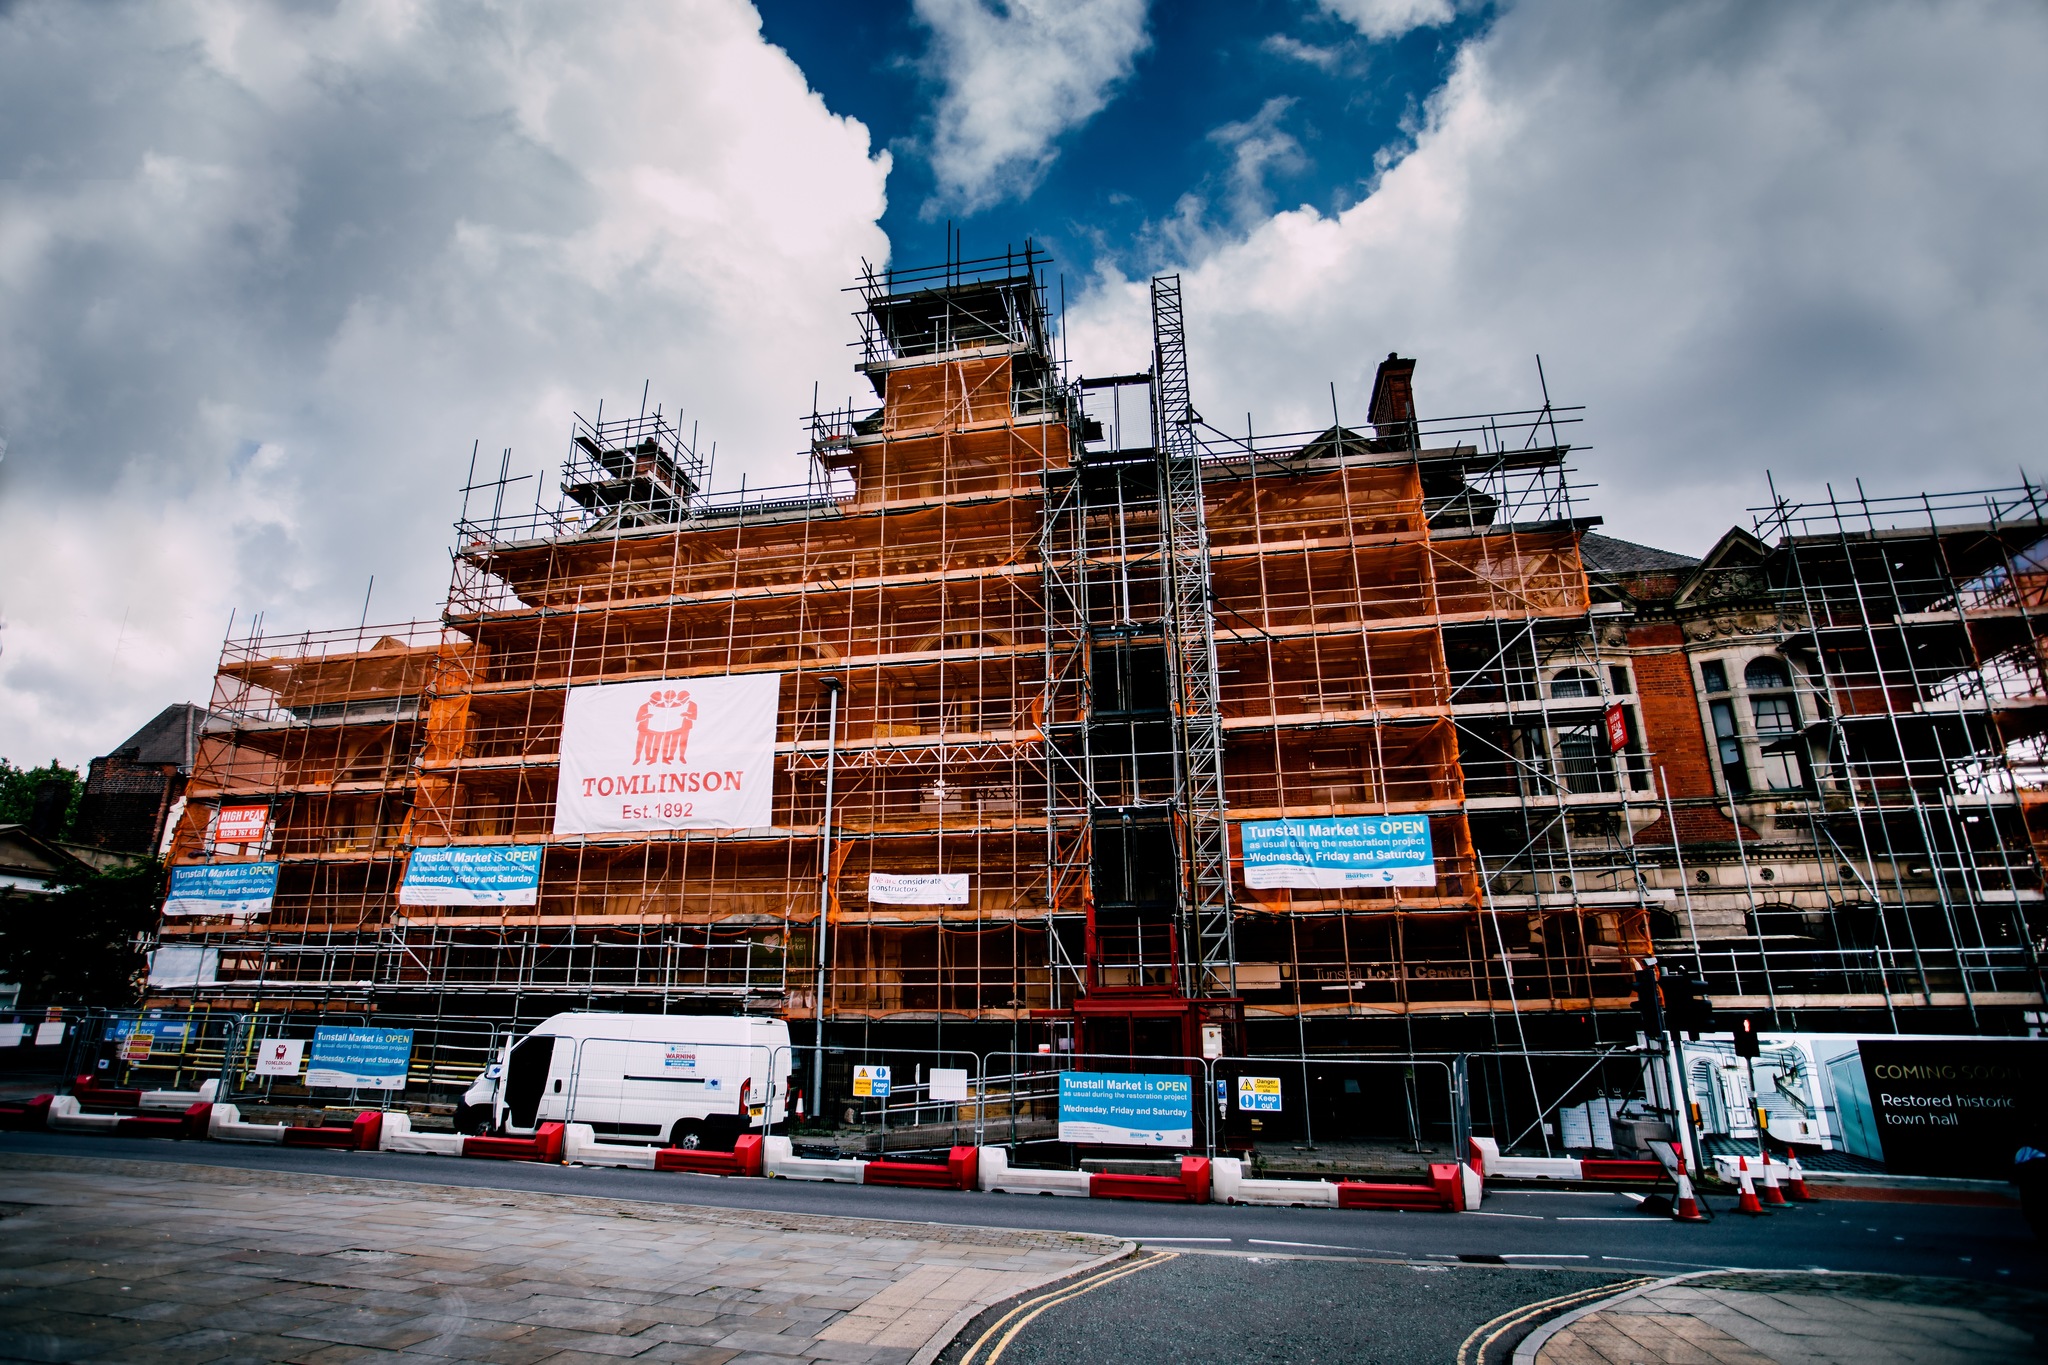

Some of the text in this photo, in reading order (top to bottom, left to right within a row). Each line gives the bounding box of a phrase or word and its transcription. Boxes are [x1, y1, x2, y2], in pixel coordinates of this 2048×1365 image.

[582, 771, 744, 797] TOMLINSON
[221, 809, 266, 821] HIGH PEAK
[1249, 822, 1424, 838] Tunstall Market is OPEN
[1262, 840, 1287, 848] usual
[1290, 840, 1319, 850] during
[1321, 840, 1336, 848] the
[1338, 838, 1390, 847] restoration
[1392, 837, 1425, 848] project
[414, 851, 537, 862] Tunstall Market is OPEN
[1250, 850, 1425, 863] Wednesday, Friday and Saturday
[176, 866, 275, 879] Tunstall Market is OPEN
[511, 864, 535, 872] project
[409, 875, 453, 884] Wednesday,
[456, 875, 479, 884] Friday
[498, 874, 533, 884] Saturday
[172, 888, 206, 896] Wednesday,
[208, 887, 226, 896] Friday
[242, 886, 271, 894] Saturday
[872, 884, 917, 892] constructors
[1367, 966, 1409, 980] Local
[1415, 966, 1470, 978] Centre
[317, 1032, 410, 1043] Tunstall Market is OPEN
[313, 1054, 346, 1063] Wednesday,
[346, 1056, 364, 1064] Friday
[377, 1057, 405, 1065] Saturday
[1874, 1064, 1956, 1079] COMING
[1064, 1078, 1187, 1091] Tunstall Market is OPEN
[1092, 1091, 1113, 1099] during
[1126, 1092, 1162, 1100] restoration
[1880, 1094, 2016, 1108] Restored historic
[1064, 1104, 1187, 1117] Wednesday, Friday and Saturday
[1885, 1112, 1958, 1125] town hall
